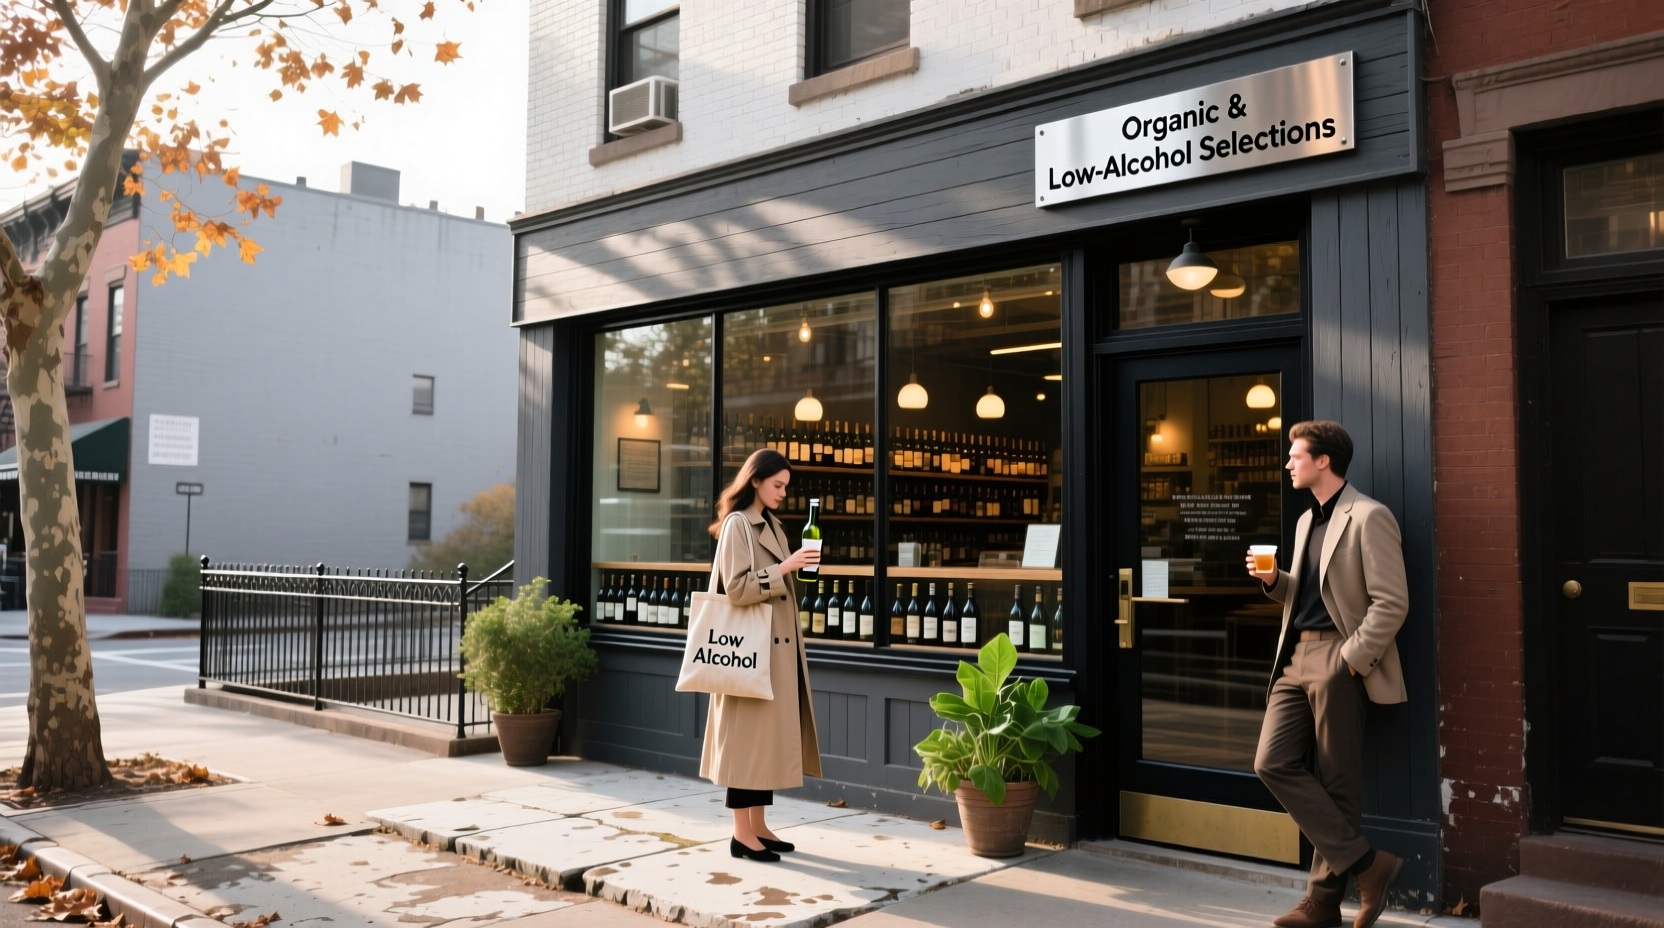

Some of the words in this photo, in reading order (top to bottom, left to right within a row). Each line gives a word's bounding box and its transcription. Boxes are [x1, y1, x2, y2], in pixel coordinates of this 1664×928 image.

[1121, 100, 1220, 142] Organic
[1227, 93, 1247, 120] &
[1049, 140, 1192, 190] Low-Alcohol
[1199, 117, 1336, 161] Selections
[708, 628, 744, 648] Low
[692, 647, 757, 669] Alcohol
